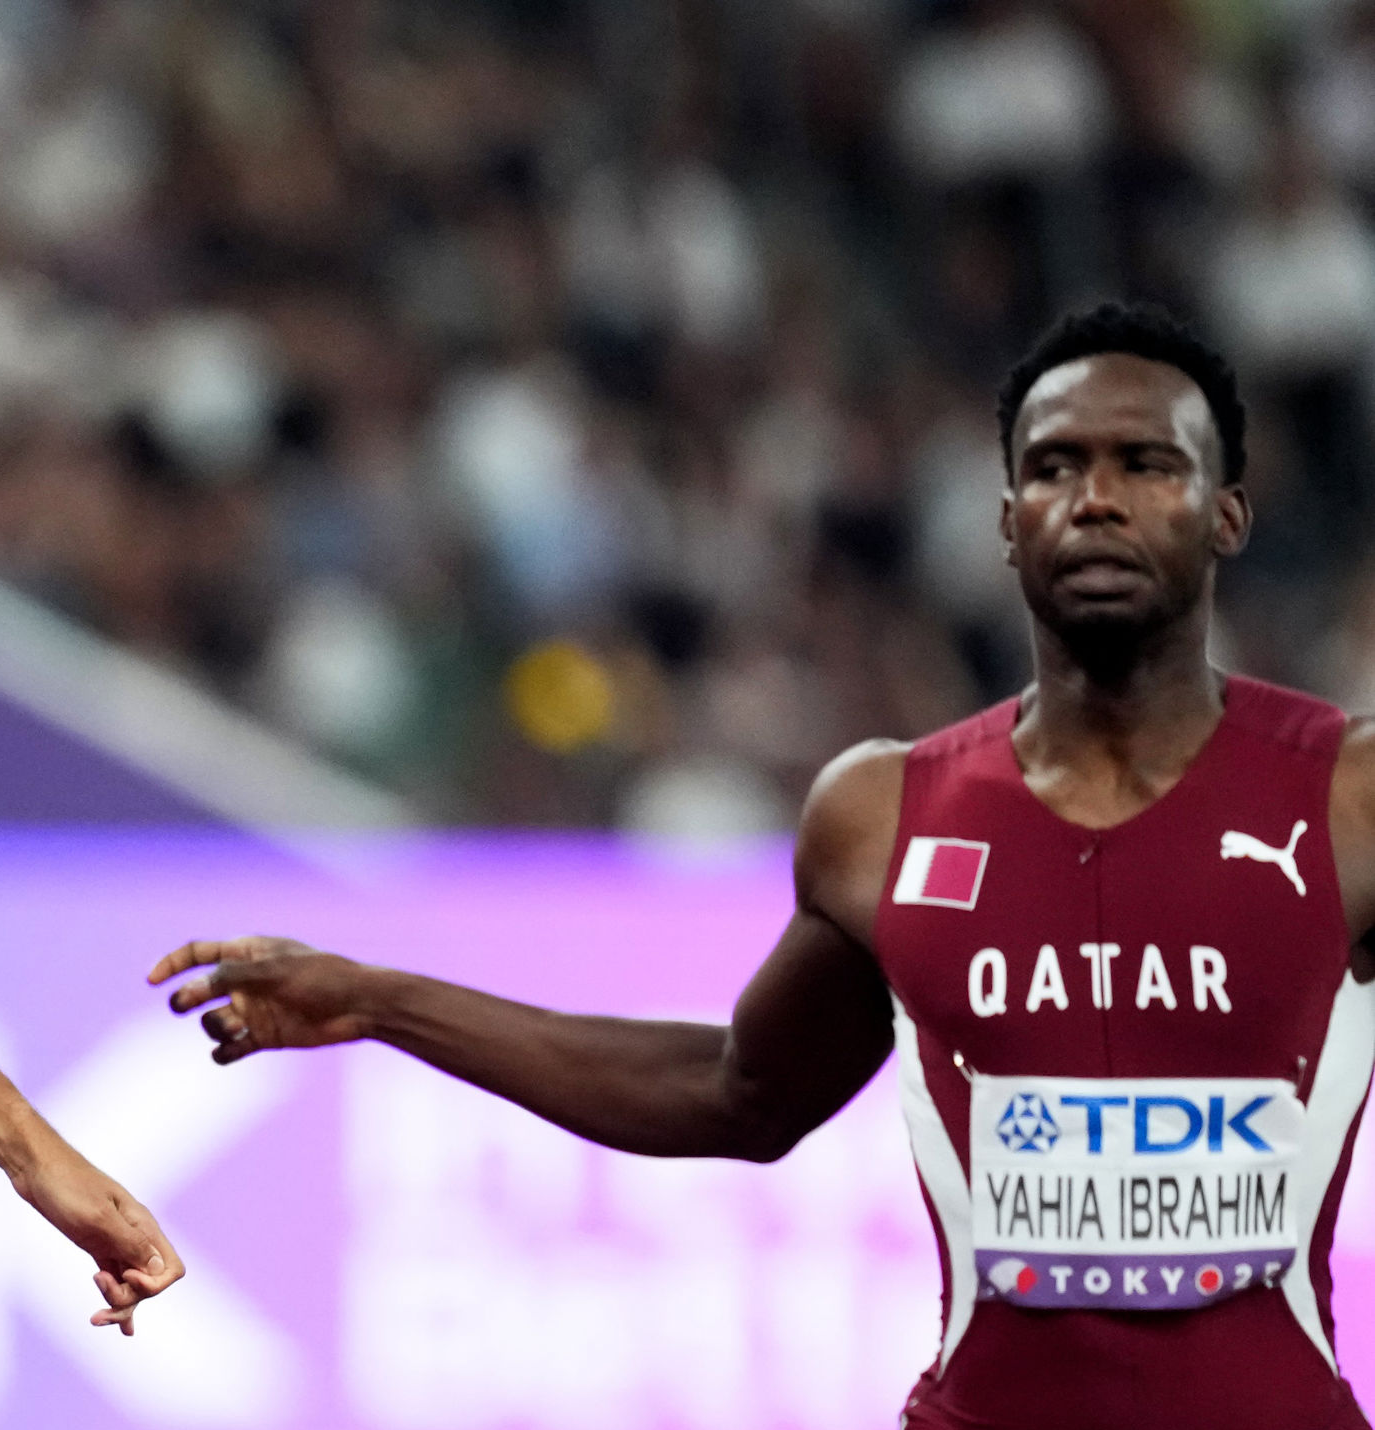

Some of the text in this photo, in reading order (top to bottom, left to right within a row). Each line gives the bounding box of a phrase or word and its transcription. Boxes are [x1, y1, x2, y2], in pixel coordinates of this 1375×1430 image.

[968, 943, 1232, 1018] QATAR
[1060, 1095, 1276, 1154] TDK
[987, 1172, 1288, 1239] YAHIA IBRAHIM
